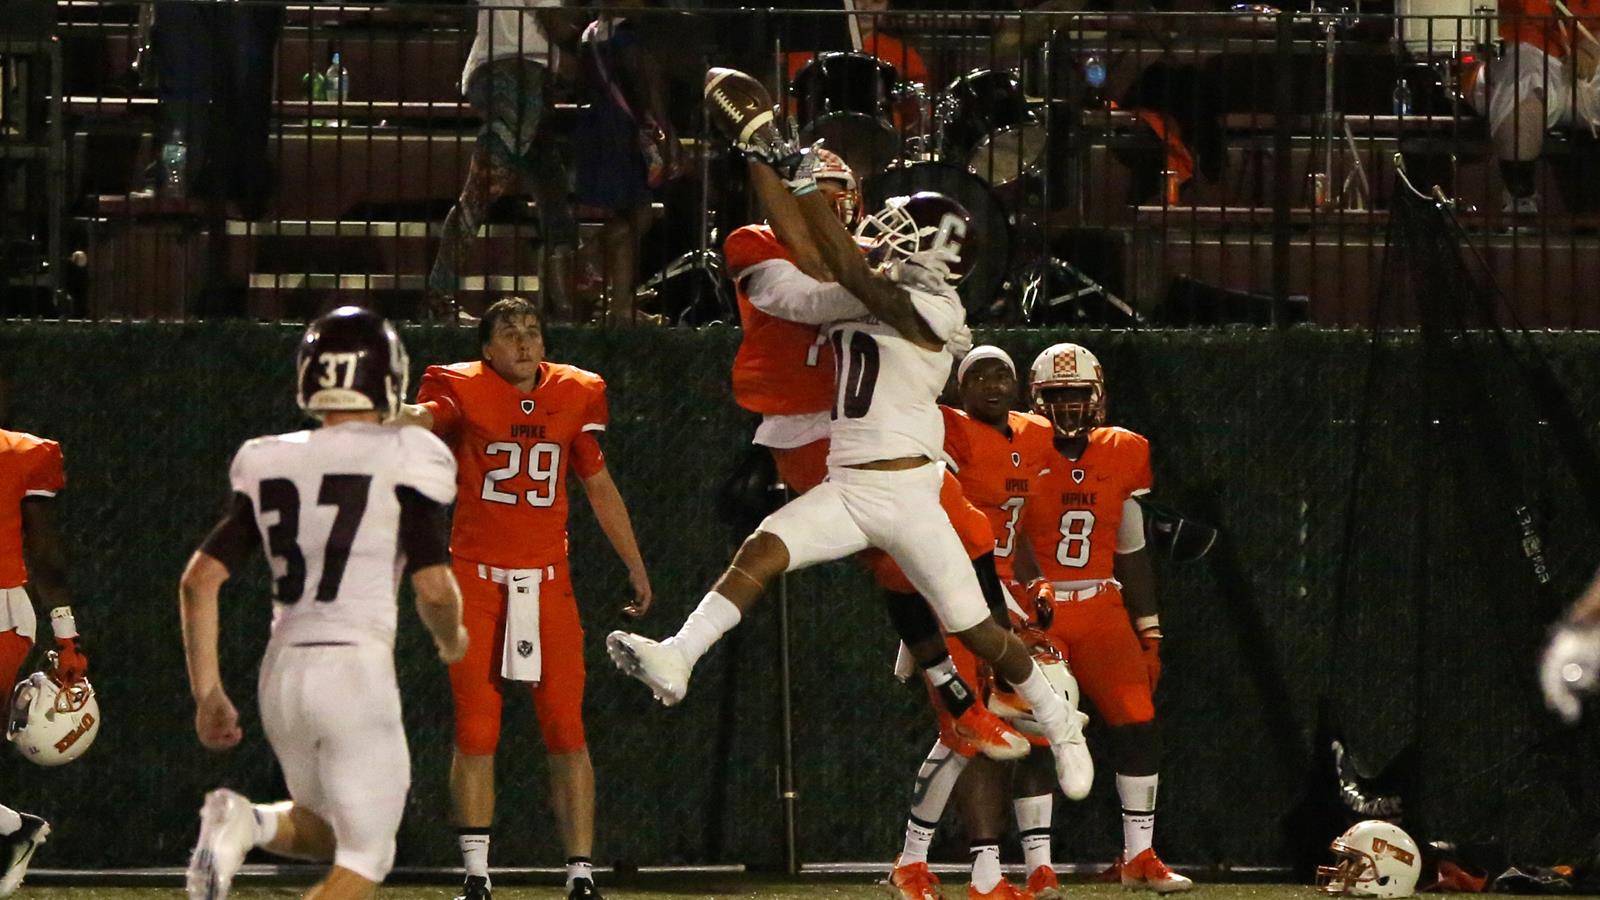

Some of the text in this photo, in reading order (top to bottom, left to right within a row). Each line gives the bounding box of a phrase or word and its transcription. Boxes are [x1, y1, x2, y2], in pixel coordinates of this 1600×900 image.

[318, 352, 358, 389] 37
[831, 329, 880, 421] 10
[510, 424, 547, 439] UPIKE
[480, 441, 561, 508] 29
[1005, 478, 1030, 493] UPIKE
[1061, 492, 1097, 506] UPIKE
[259, 474, 373, 606] 37
[1055, 508, 1096, 568] 8
